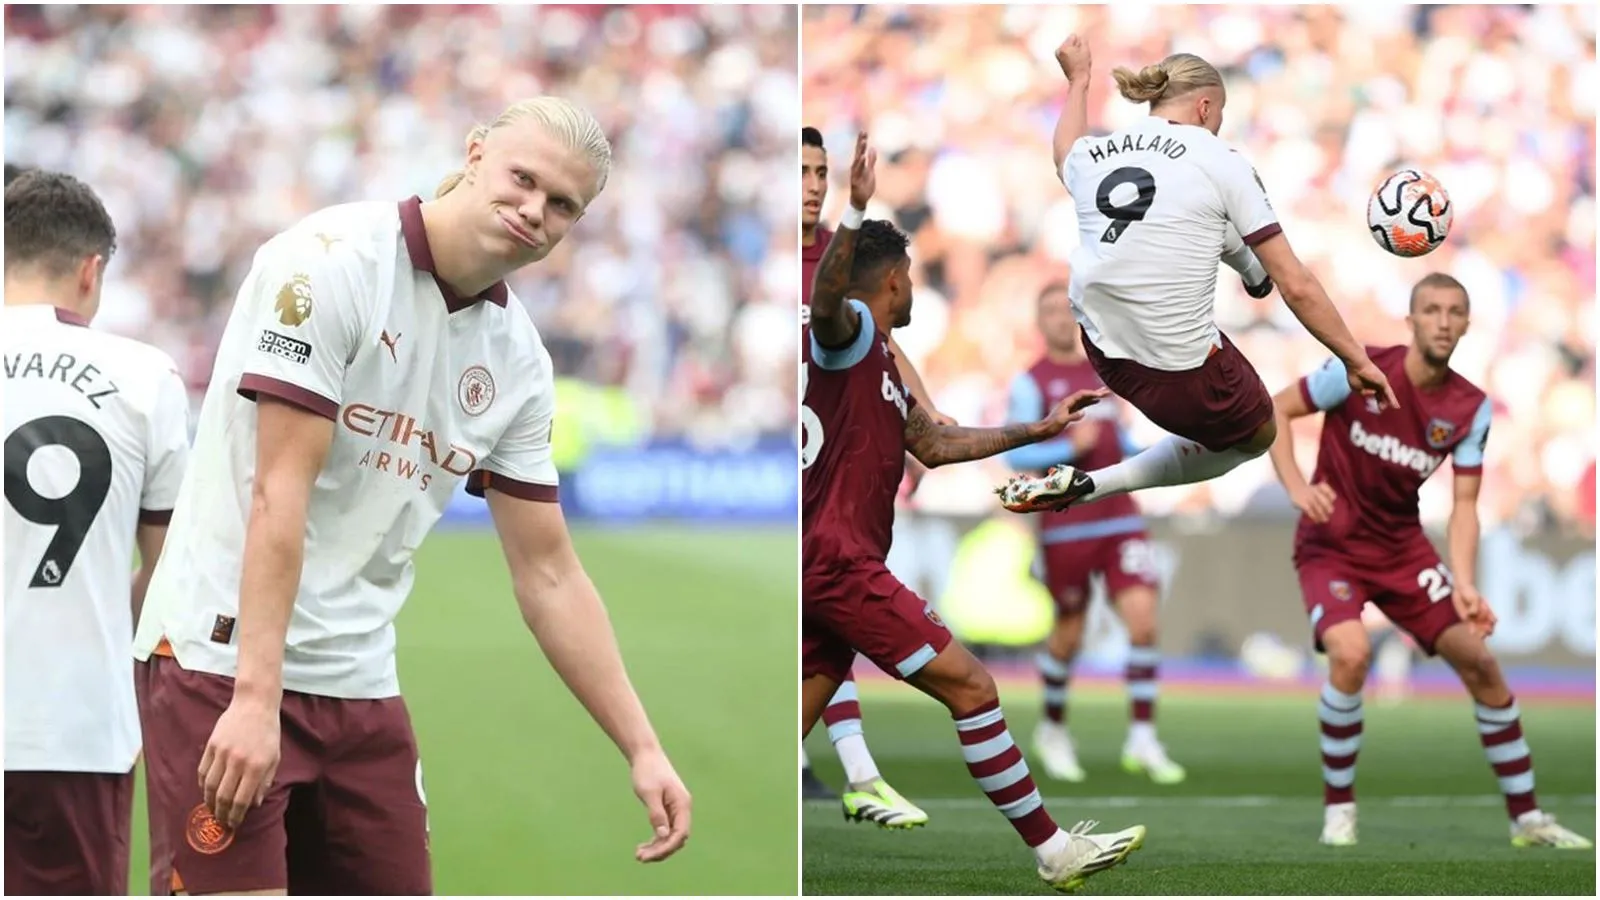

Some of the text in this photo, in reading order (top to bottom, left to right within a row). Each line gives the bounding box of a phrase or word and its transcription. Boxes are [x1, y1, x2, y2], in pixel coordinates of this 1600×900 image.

[1089, 134, 1187, 163] HAALAND
[1096, 166, 1156, 244] 9
[274, 336, 306, 355] room
[4, 352, 120, 410] VAREZ
[342, 403, 476, 476] ETIHAD
[1350, 421, 1443, 477] betway
[4, 415, 112, 588] 9
